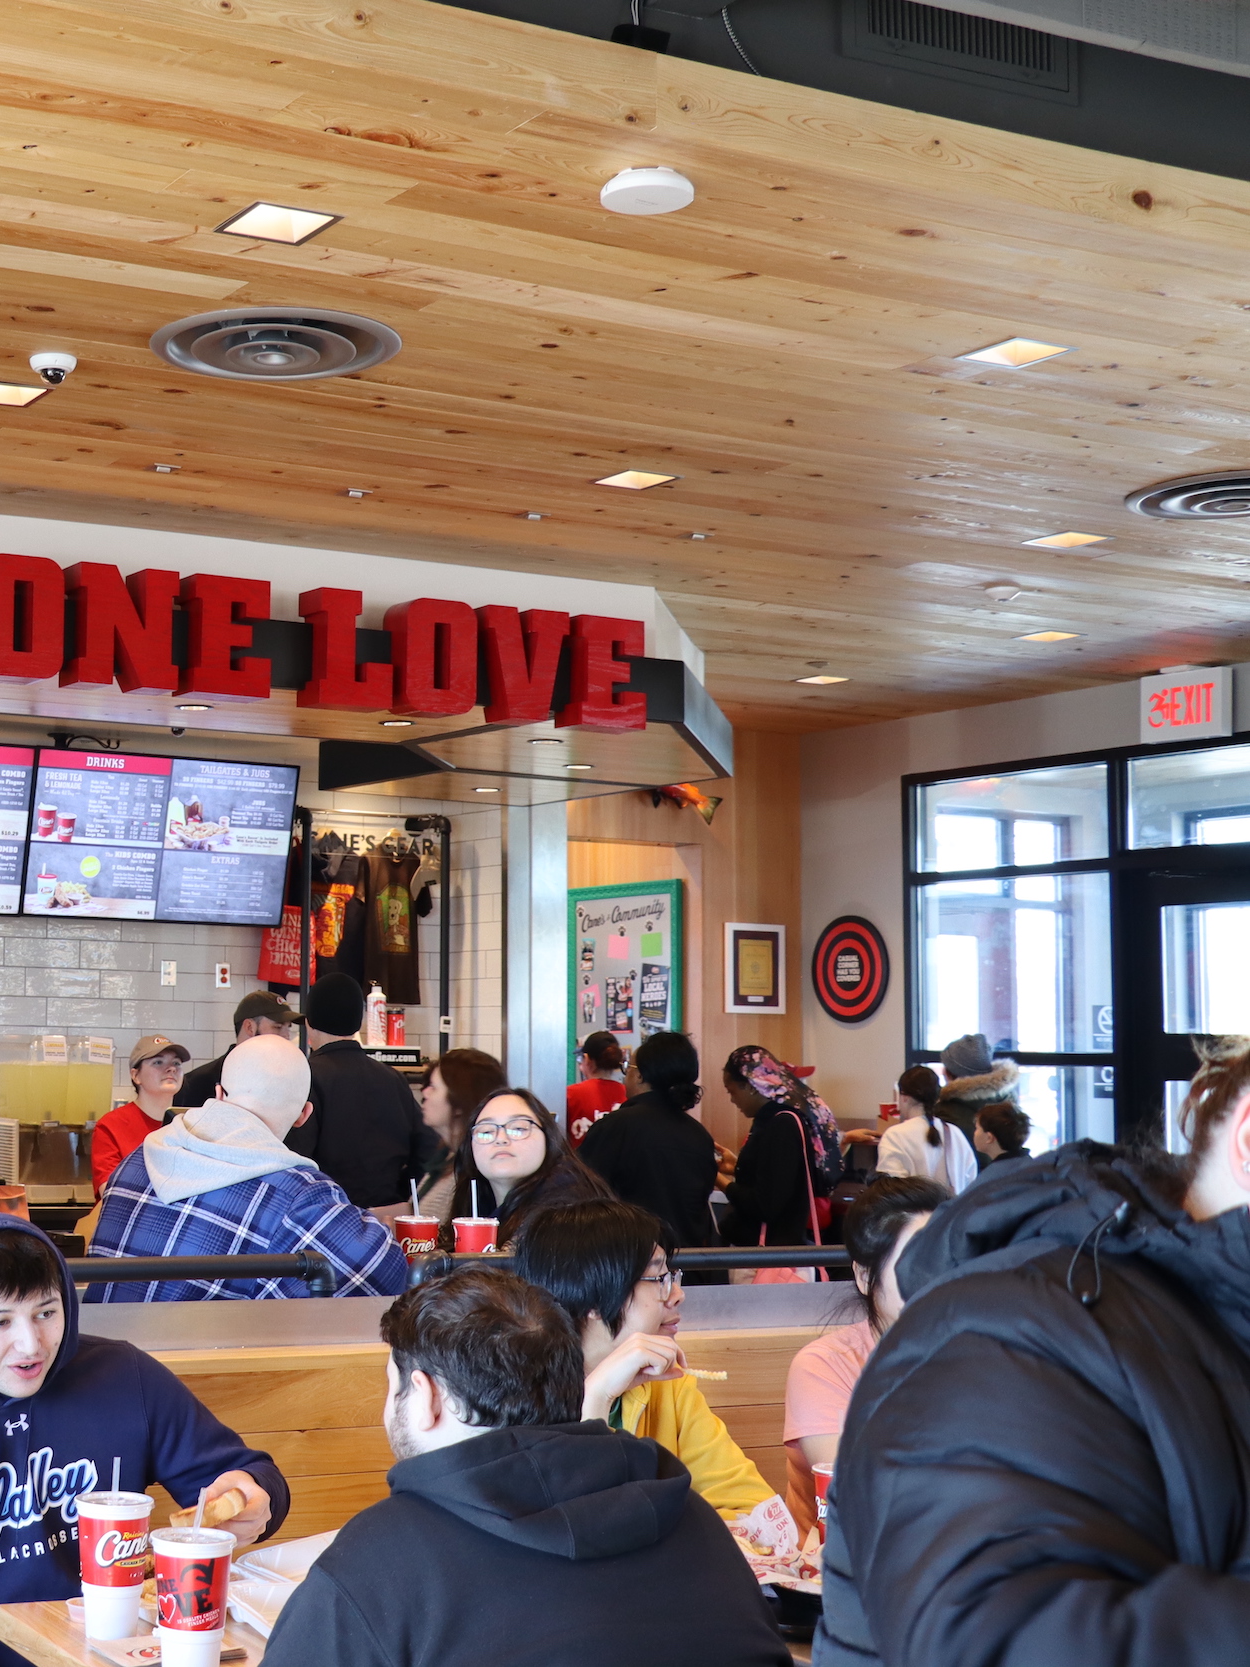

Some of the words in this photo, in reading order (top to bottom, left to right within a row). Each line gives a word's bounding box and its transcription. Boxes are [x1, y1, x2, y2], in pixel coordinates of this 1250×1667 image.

[297, 586, 647, 732] LOVE
[1170, 682, 1215, 727] EXIT
[86, 757, 125, 768] DRINKS
[1, 769, 26, 778] COMBO
[46, 772, 68, 781] FRESH
[70, 773, 82, 781] TEA
[200, 765, 241, 776] TAILGATES
[251, 769, 270, 778] JUGS
[50, 781, 82, 790] LEMONADE
[211, 856, 240, 865] EXTRAS
[611, 899, 665, 923] Community
[644, 982, 665, 993] LOCAL
[641, 991, 666, 1002] HEROES
[401, 1237, 436, 1256] Cane's
[95, 1530, 148, 1568] Cane
